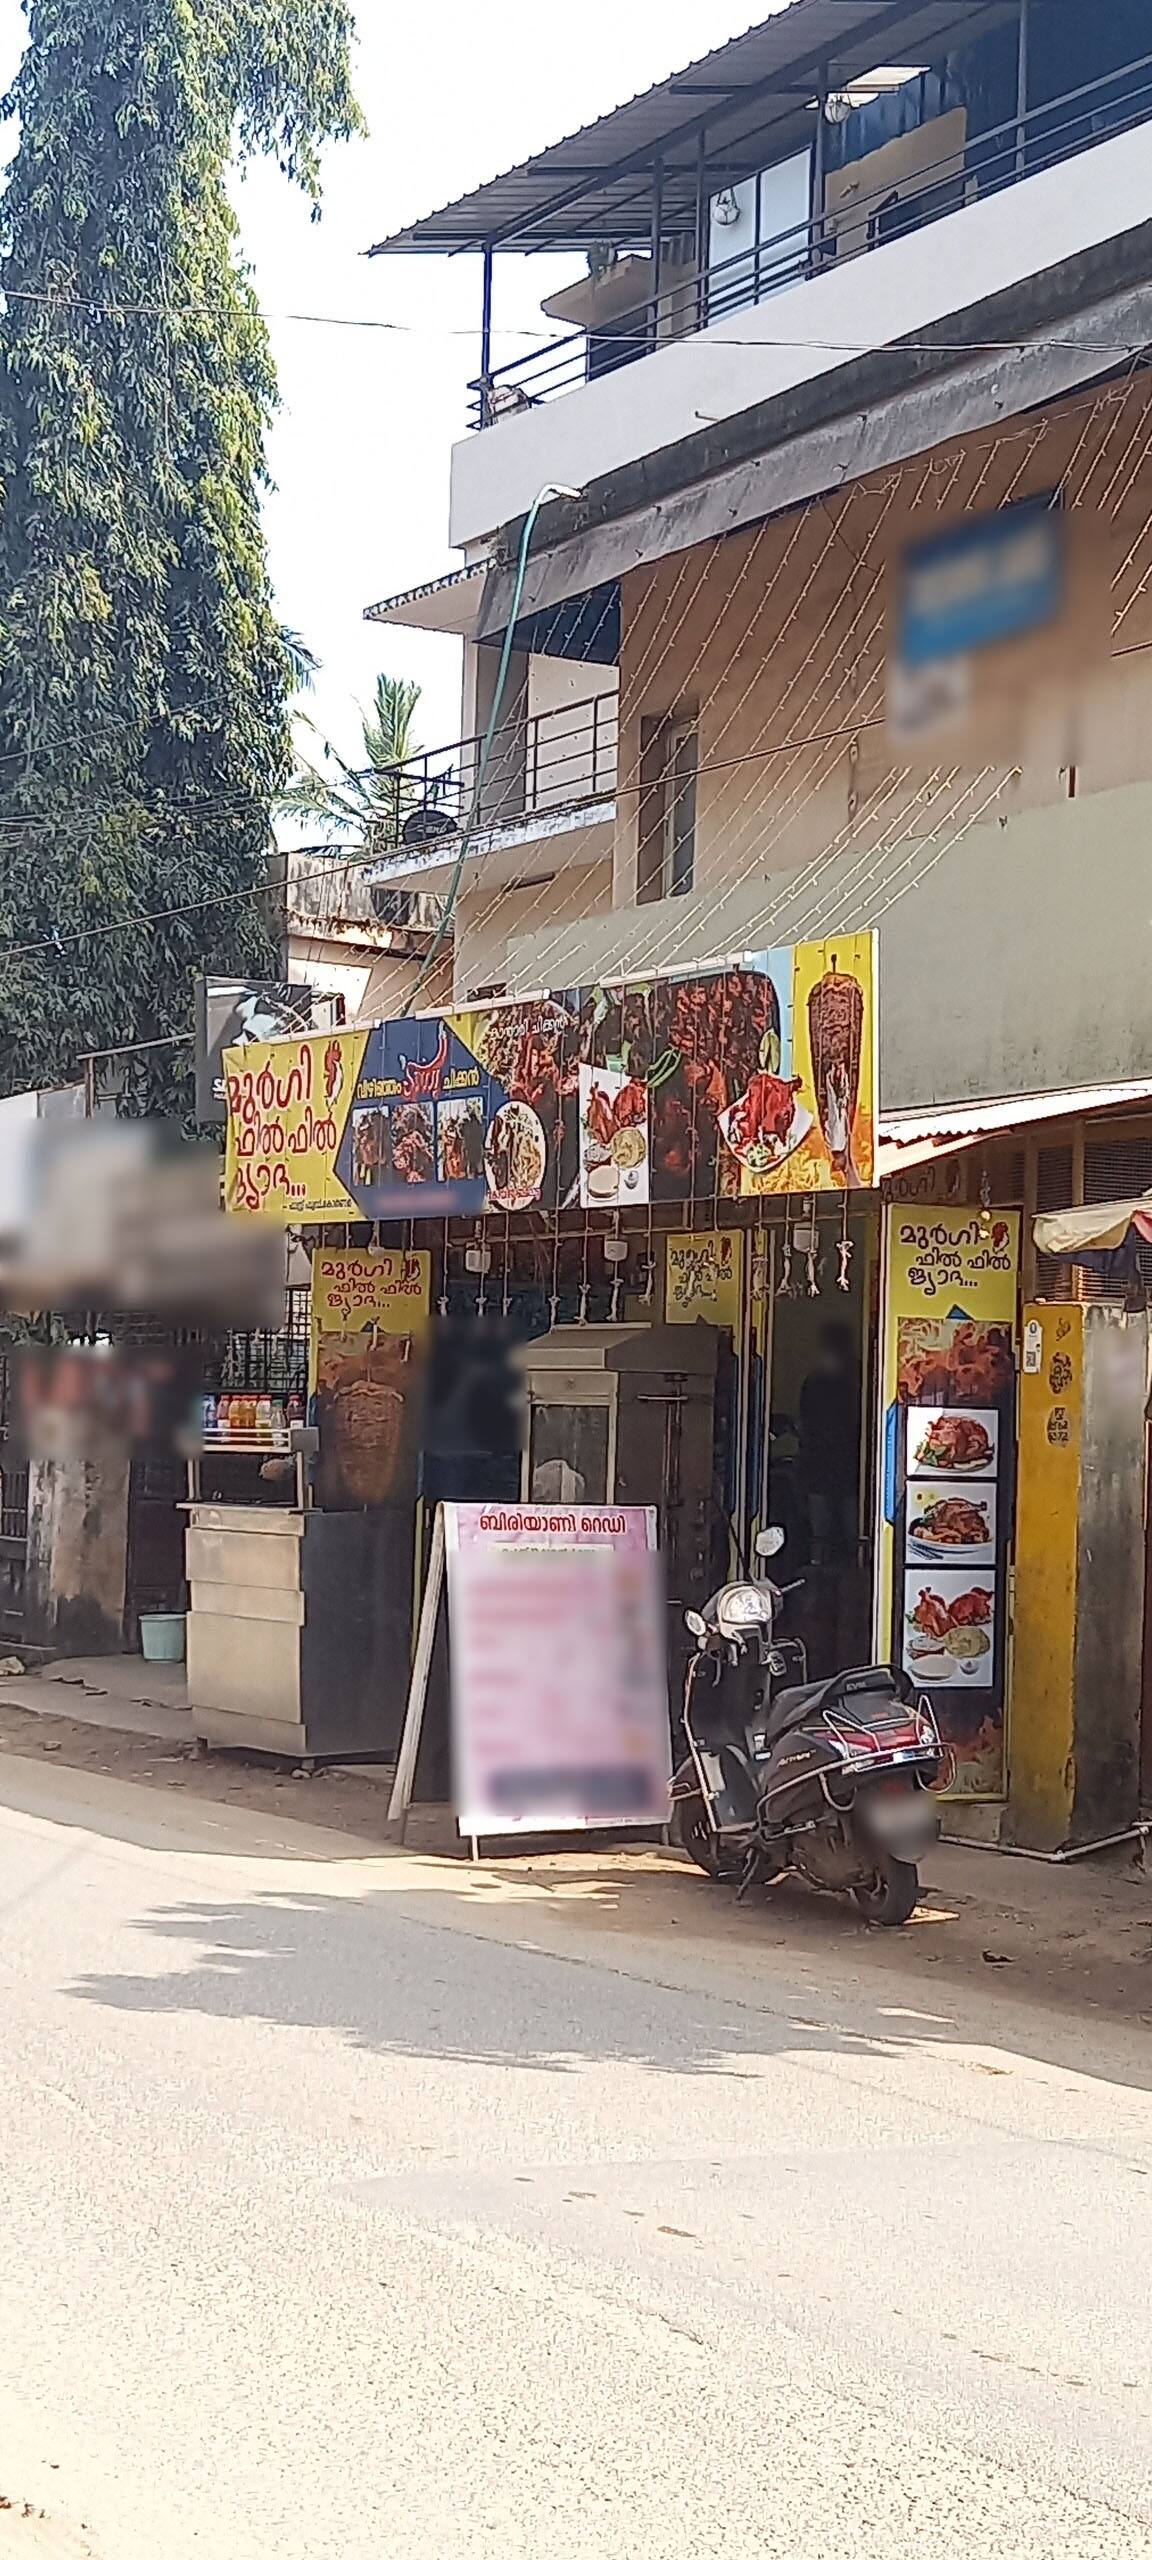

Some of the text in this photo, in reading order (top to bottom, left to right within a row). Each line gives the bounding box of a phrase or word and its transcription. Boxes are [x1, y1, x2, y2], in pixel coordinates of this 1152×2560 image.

[235, 1105, 337, 1156] ഫിൽ ഫിൽ
[900, 1221, 980, 1249] മുർഗി
[321, 1258, 392, 1280] മുർഗി
[916, 1247, 1011, 1270] ഫിൽ ഫിൽ
[333, 1278, 422, 1295] ഫിൽ ഫിൽ
[480, 1512, 626, 1533] ബിരിയാണി റെഡി
